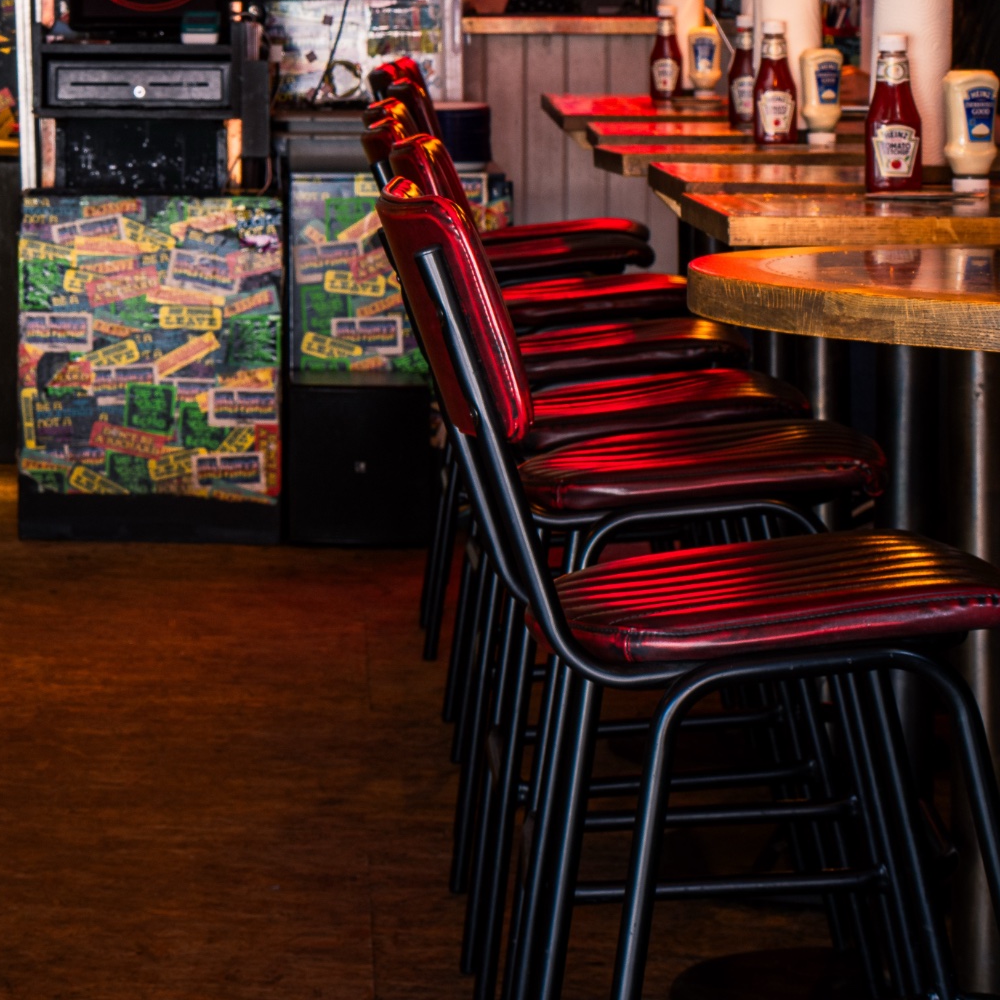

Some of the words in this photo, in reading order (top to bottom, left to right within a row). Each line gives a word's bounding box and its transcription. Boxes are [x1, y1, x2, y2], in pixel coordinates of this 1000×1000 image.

[884, 130, 908, 140] HEINZ
[330, 281, 380, 292] LEAVE
[165, 316, 217, 326] LEAVE
